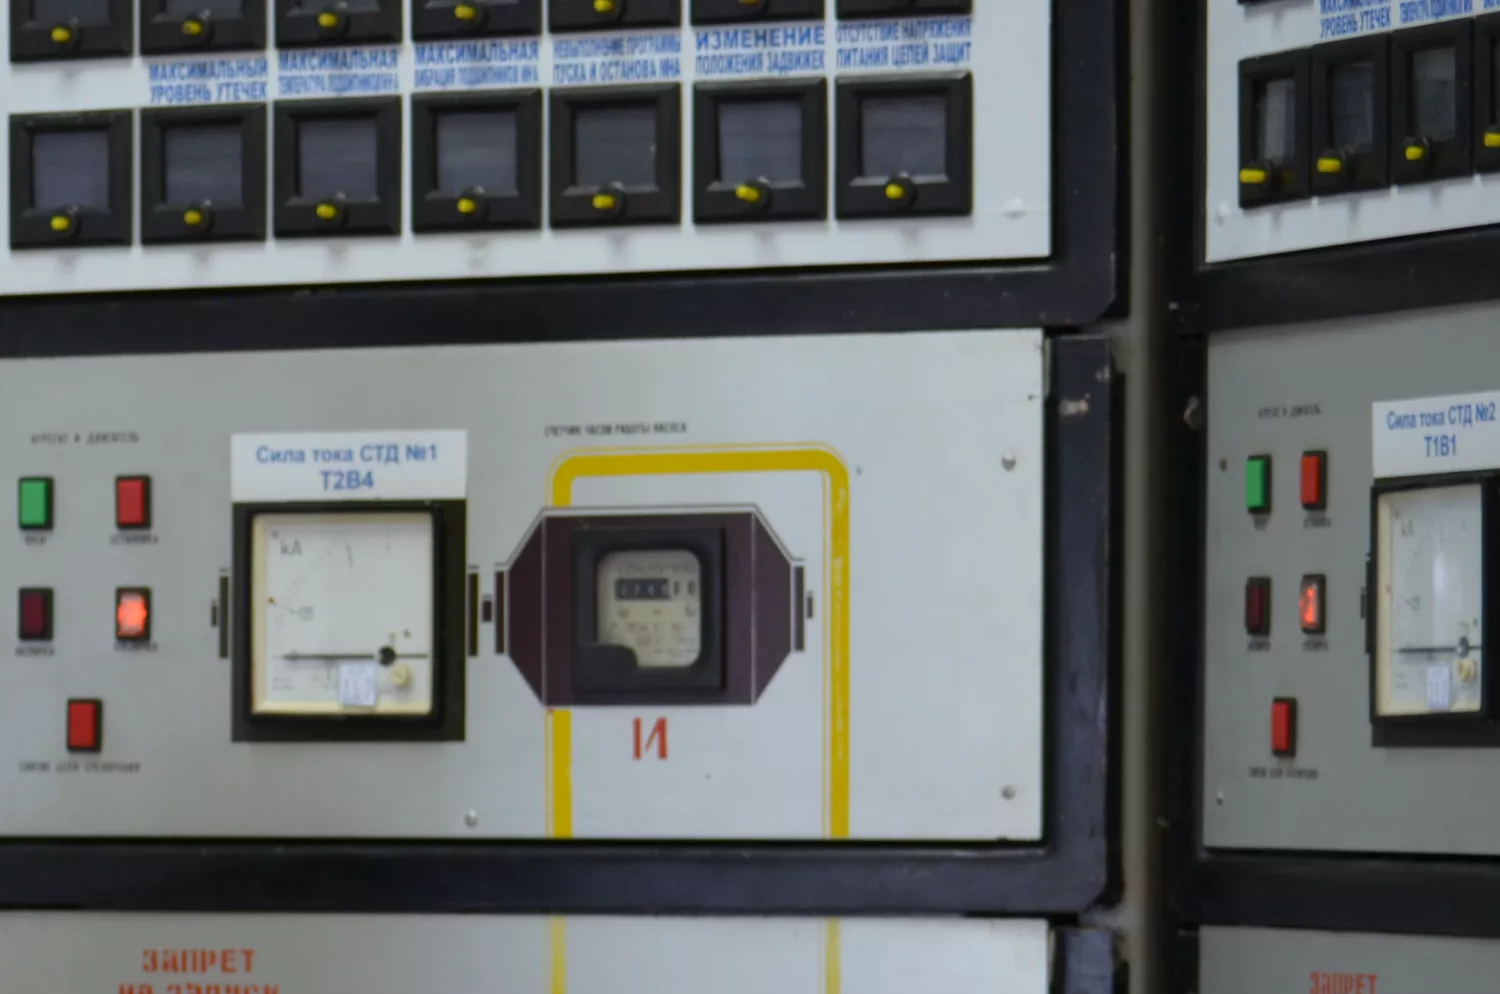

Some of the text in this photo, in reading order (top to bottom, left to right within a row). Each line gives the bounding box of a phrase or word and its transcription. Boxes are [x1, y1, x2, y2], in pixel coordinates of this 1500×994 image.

[696, 24, 825, 50] ИЗМЕНЕНИЕ
[278, 48, 398, 72] МАКСИМАЛЬНАЯ
[414, 40, 538, 64] МАКСИМАЛЬНАЯ
[836, 46, 888, 68] ПИТАНИЯ
[932, 41, 971, 66] ЗАЩИТ
[149, 57, 267, 81] МАКСИМАЛЬНЫЙ
[150, 80, 268, 104] УРОВЕНЬ УТЕЧЕК
[1387, 401, 1496, 430] Сила тока СТД №2
[256, 443, 437, 464] Сила тока СТД №1
[632, 716, 668, 760] И
[141, 948, 255, 974] ЗАПРЕТ
